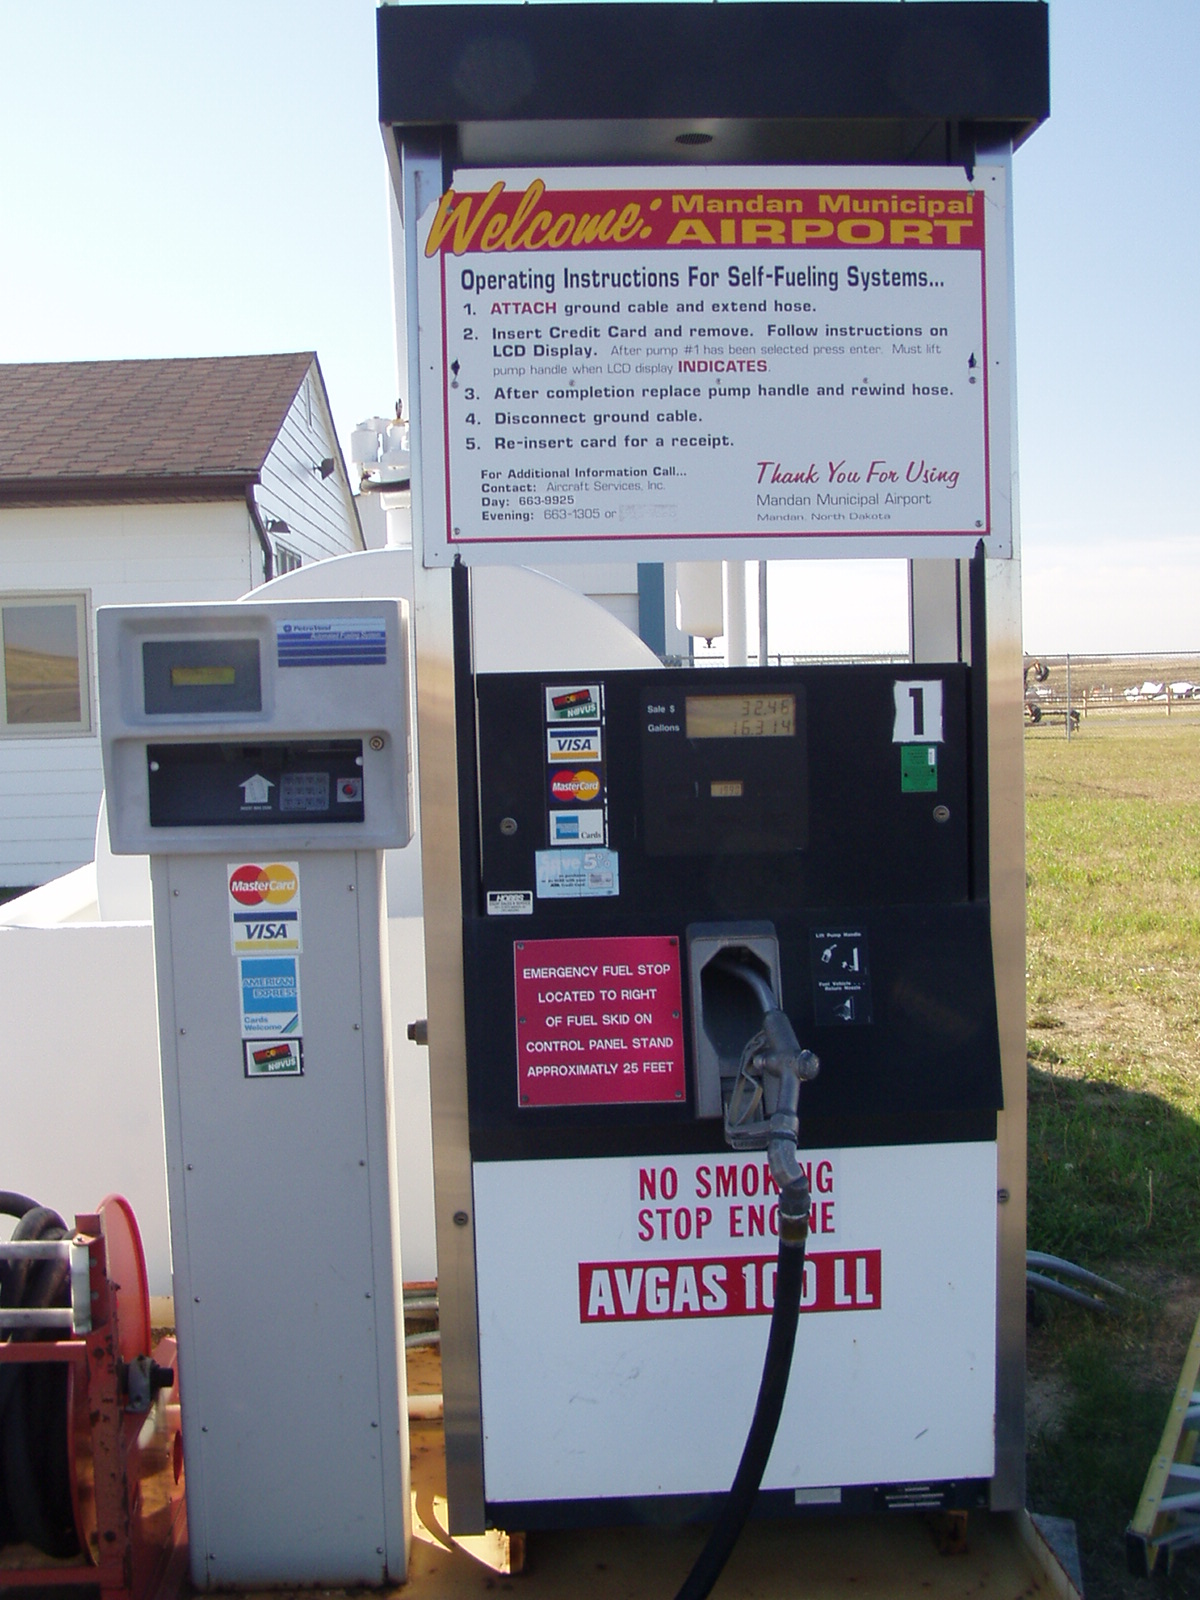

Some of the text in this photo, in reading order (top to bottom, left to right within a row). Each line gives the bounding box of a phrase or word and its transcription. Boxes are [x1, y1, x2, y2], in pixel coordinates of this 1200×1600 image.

[671, 194, 803, 214] Mandan
[818, 192, 974, 217] Municipal
[666, 218, 974, 245] AIRPORT
[461, 265, 945, 295] Operating Instructions For Self-Fueling Systems...
[463, 300, 817, 316] 1. ATTACH ground cable and extend hose.
[463, 324, 948, 341] 2. Insert Credit Card and remove. Follow instructions on
[493, 343, 942, 359] LCD Display. After pump #1 has been selected press enter. Must lift
[493, 366, 526, 378] pump
[530, 364, 568, 376] handle
[572, 364, 603, 375] when
[607, 363, 632, 375] LCD
[635, 362, 674, 377] display
[464, 383, 954, 401] 3. After completion replace pump handle and rewind hose.
[465, 409, 703, 426] 4. Disconnect ground cable.
[465, 434, 735, 451] 5. Re-insert card for a receipt.
[481, 466, 688, 480] For Additional Information Call...
[756, 460, 960, 489] Thank You For Using
[481, 480, 666, 494] Contact: Aircraft Services, Inc.
[481, 494, 575, 509] Day: 663-9925
[756, 492, 932, 507] Mandan Municipal Airport
[481, 510, 534, 522] Evening:
[543, 507, 600, 520] 663-1305
[604, 510, 617, 519] or
[811, 511, 845, 521] North
[848, 511, 892, 521] Dakota
[567, 703, 597, 718] NOVUS
[647, 704, 666, 714] Sale
[669, 704, 676, 714] $
[908, 687, 925, 736] 1
[647, 723, 681, 733] Gallons
[556, 738, 593, 752] VISA
[551, 781, 600, 793] MasterCard
[580, 831, 602, 840] Cards
[231, 879, 296, 893] MasterCard
[245, 923, 288, 940] VISA
[523, 963, 671, 980] EMERGENCY FUEL STOP
[242, 976, 295, 988] AMERICAN
[252, 987, 298, 999] EXPRESS
[538, 988, 657, 1004] LOCATED TO RIGHT
[244, 1016, 269, 1024] Cards
[244, 1023, 283, 1032] Welcome
[545, 1013, 652, 1028] OF FUEL SKID ON
[526, 1036, 674, 1053] CONTROL PANEL STAND
[268, 1058, 297, 1072] NOVUS
[527, 1061, 674, 1078] APPROXIMATLY 25 FEET
[639, 1160, 834, 1201] NO SMOKNG
[638, 1201, 835, 1242] STOP ENGNE
[587, 1264, 728, 1317] AVGAS
[834, 1257, 874, 1306] LL
